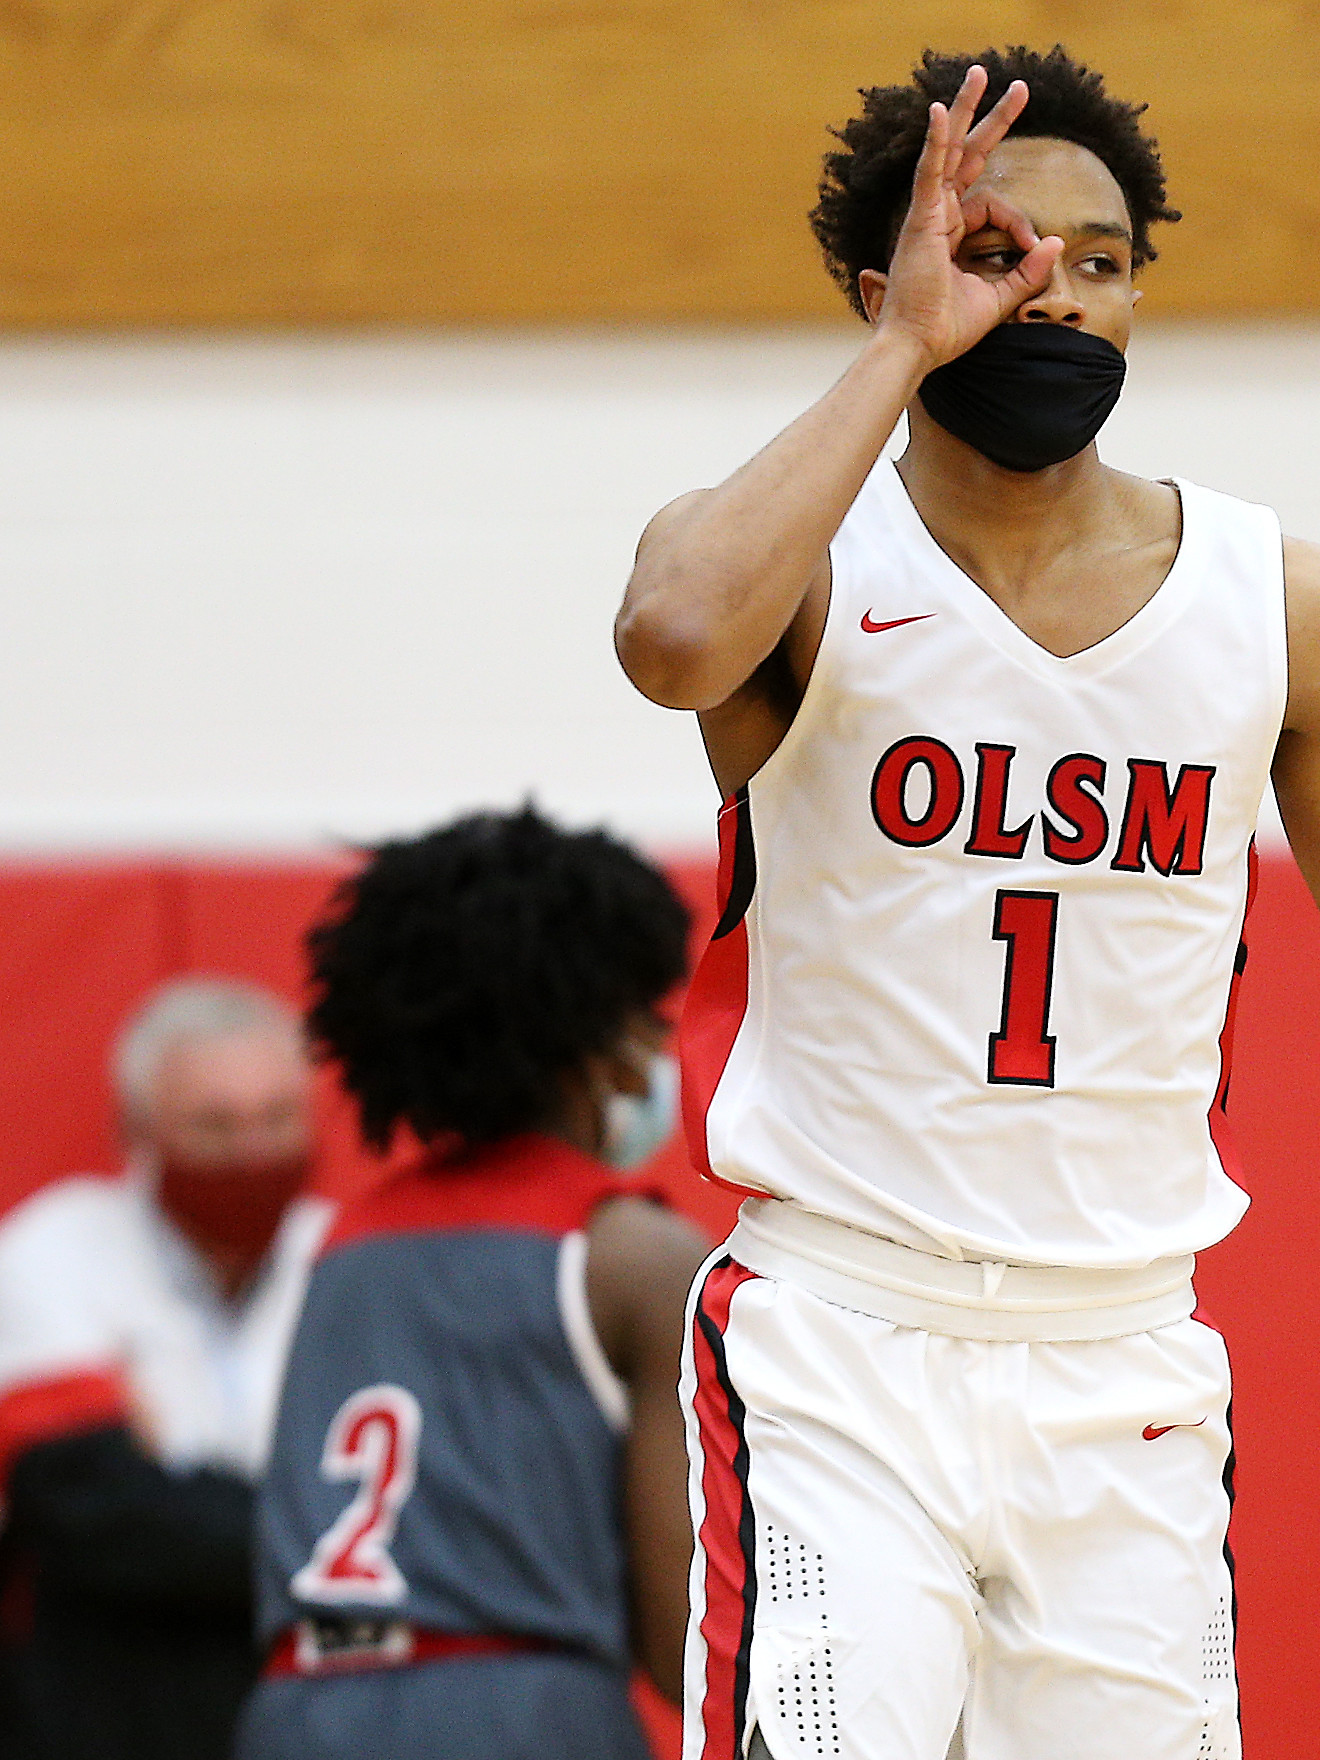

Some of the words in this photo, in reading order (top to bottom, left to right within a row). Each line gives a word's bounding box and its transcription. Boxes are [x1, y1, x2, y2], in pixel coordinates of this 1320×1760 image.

[870, 735, 1217, 877] OLSM
[986, 888, 1060, 1088] 1
[290, 1382, 424, 1605] 2
